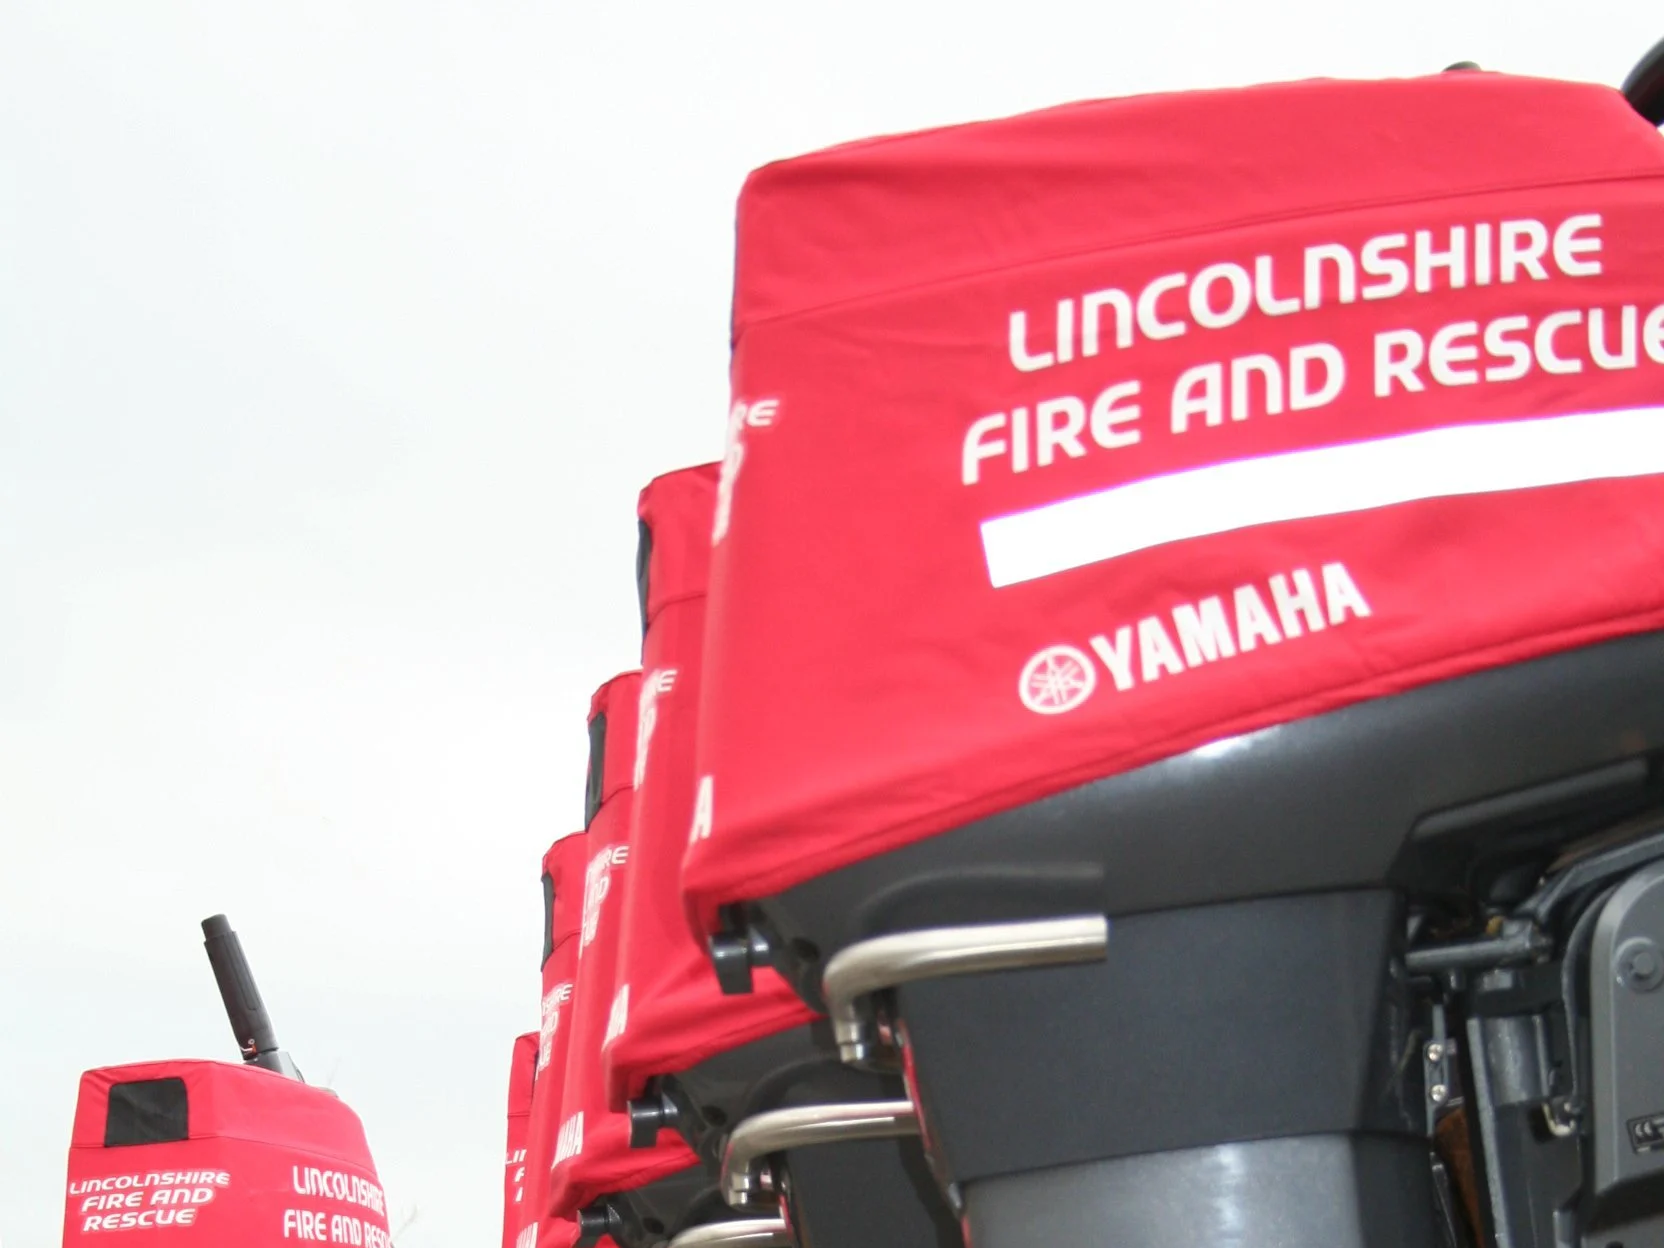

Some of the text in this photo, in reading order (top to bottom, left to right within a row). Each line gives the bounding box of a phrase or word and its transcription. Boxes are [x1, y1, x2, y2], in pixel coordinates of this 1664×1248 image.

[1009, 214, 1602, 372] LINCOLNSHIRE
[962, 381, 1141, 486] FIRE
[1170, 343, 1346, 434] AND
[1089, 561, 1372, 692] YAMAHA
[69, 1171, 231, 1195] LINCOLNSHIRE
[81, 1188, 213, 1212] FIRE AND
[83, 1208, 196, 1232] RESCUE
[284, 1208, 328, 1241] FIRE
[331, 1214, 362, 1246] AND
